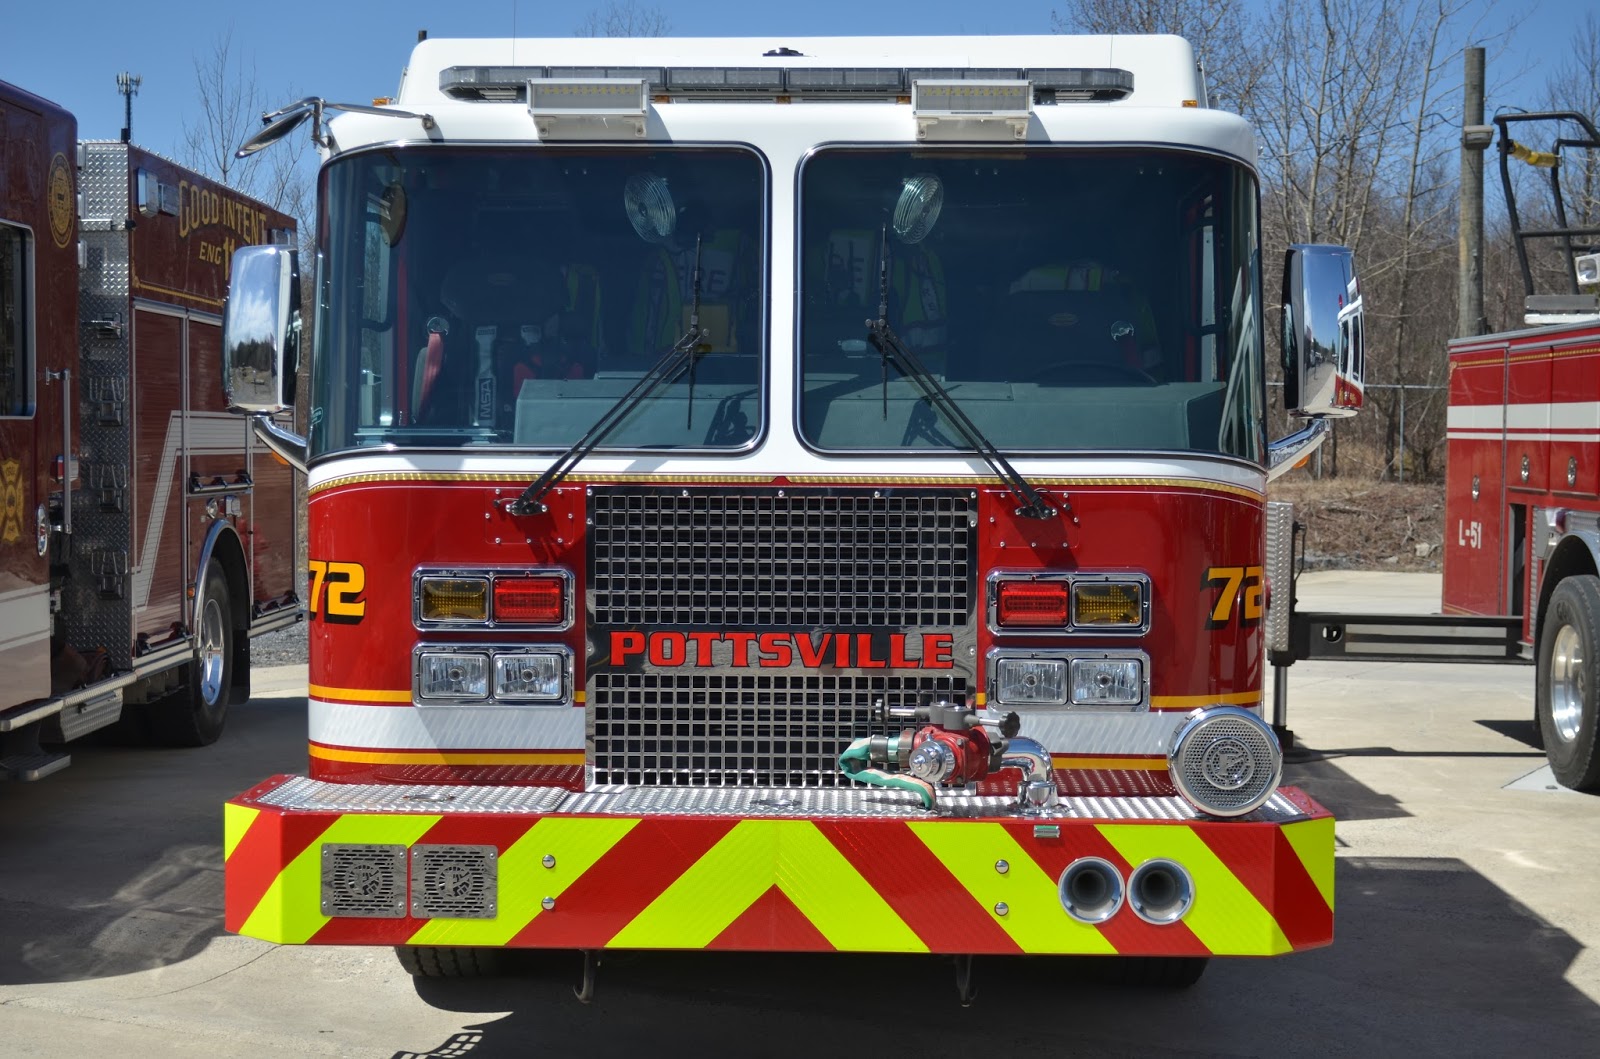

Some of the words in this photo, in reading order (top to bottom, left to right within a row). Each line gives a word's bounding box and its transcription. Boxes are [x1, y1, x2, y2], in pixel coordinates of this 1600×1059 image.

[179, 180, 220, 238] GOOD
[223, 197, 267, 246] INTENT
[199, 241, 222, 265] ENG
[480, 379, 492, 418] MSA
[1458, 518, 1482, 550] L-51
[309, 560, 366, 620] 72
[1204, 565, 1263, 624] 72
[608, 630, 955, 670] POTTSVILLE
